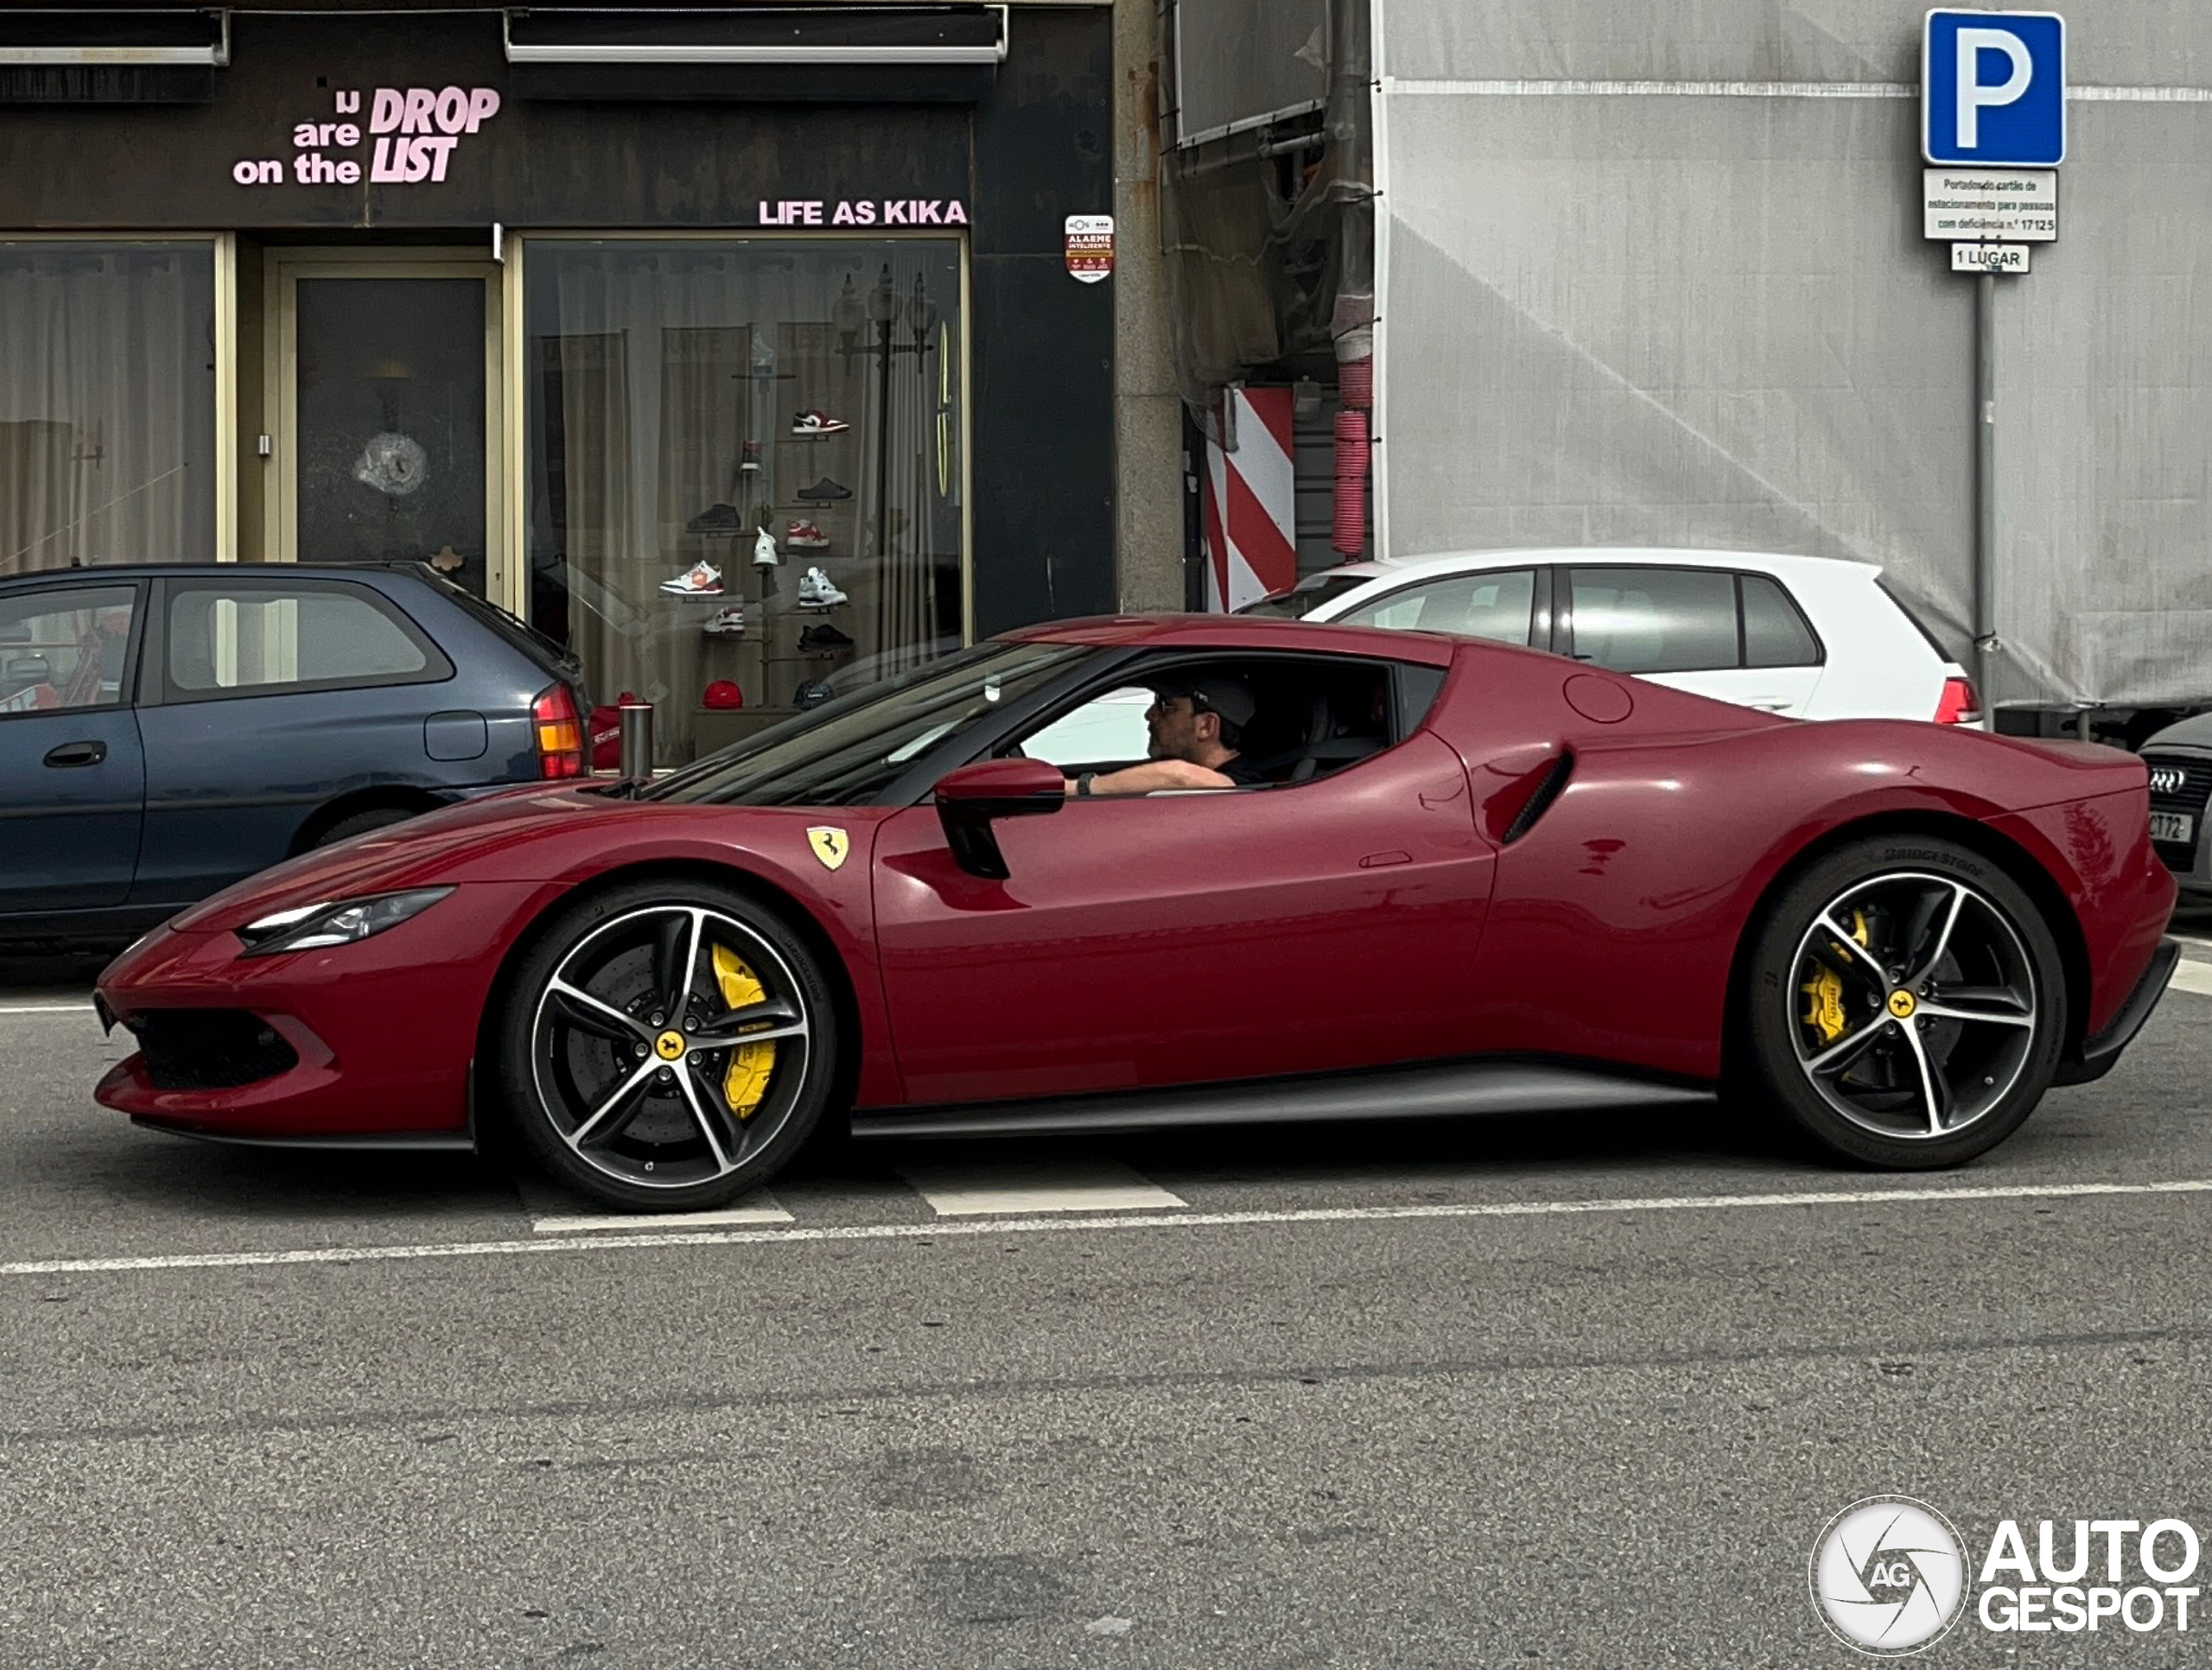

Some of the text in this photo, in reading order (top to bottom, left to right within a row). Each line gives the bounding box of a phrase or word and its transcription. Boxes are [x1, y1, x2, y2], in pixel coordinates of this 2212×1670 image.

[1956, 28, 2032, 148] P
[336, 91, 359, 113] u
[370, 86, 500, 134] DROP
[293, 123, 360, 147] are
[233, 153, 360, 184] on the
[371, 137, 458, 183] LIST
[2025, 181, 2037, 192] de
[760, 200, 968, 225] LIFE AS KIKA
[1928, 198, 2056, 213] estacionamento para pessoas
[1938, 219, 1957, 229] com
[1958, 217, 2005, 230] deficiência
[1956, 250, 2021, 265] 1 LUGAR
